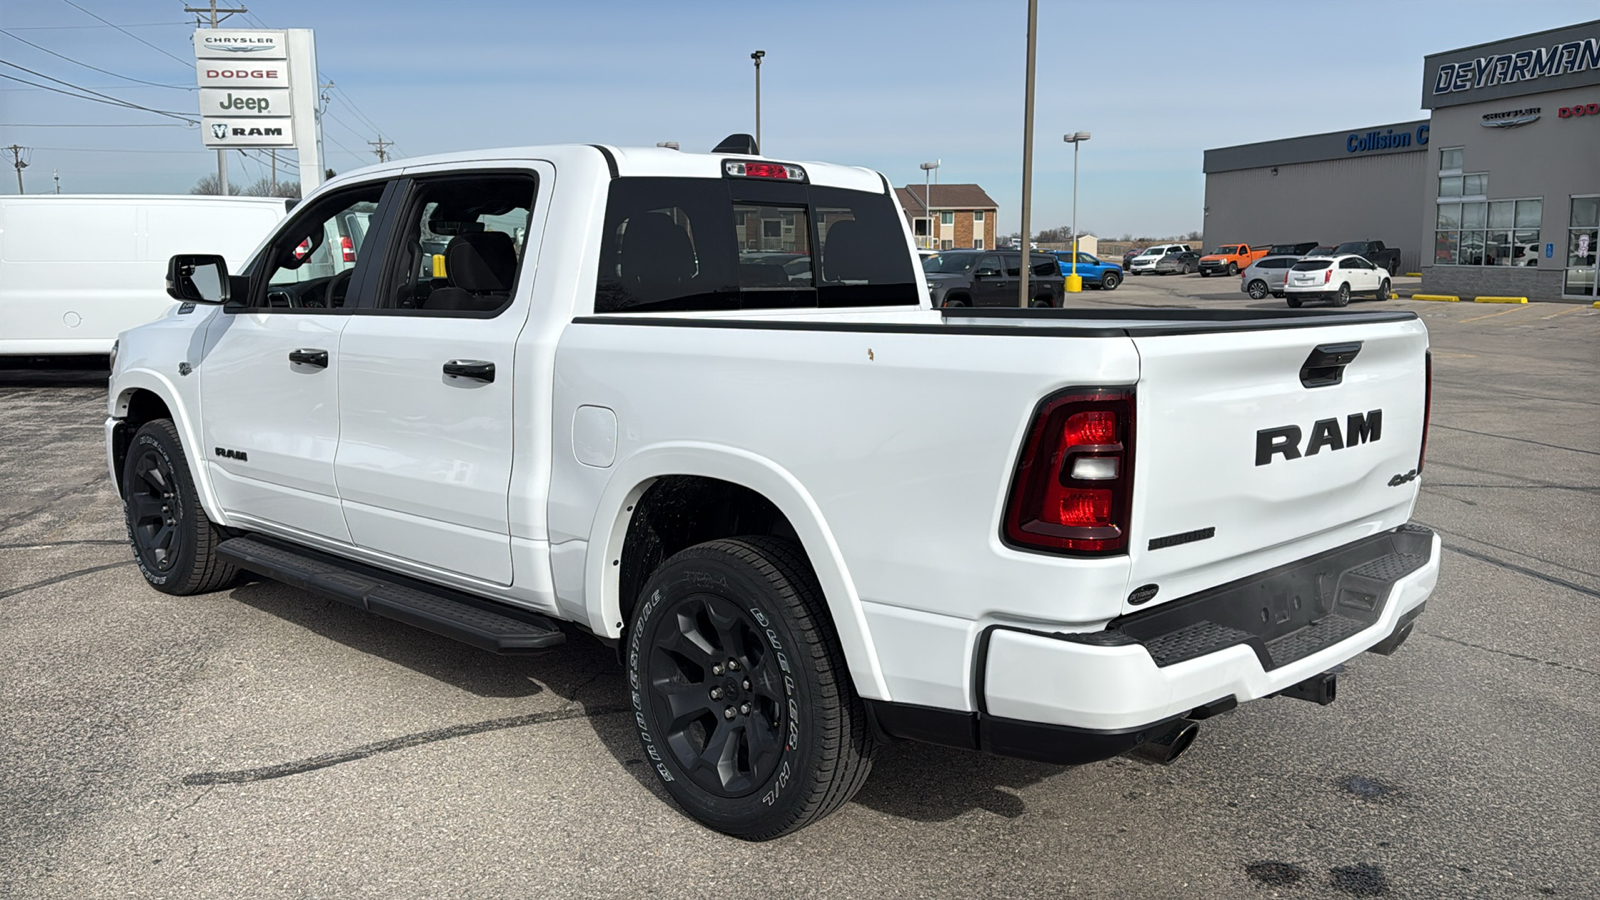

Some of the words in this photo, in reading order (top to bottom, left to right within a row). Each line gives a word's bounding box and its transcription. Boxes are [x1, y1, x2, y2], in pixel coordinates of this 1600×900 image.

[206, 69, 279, 79] DODGE
[1433, 38, 1600, 95] DEYARMAN
[219, 92, 270, 114] Jeep
[232, 127, 283, 136] RAM
[1347, 128, 1411, 153] Collision
[1255, 408, 1382, 467] RAM
[215, 446, 248, 462] RAM
[628, 589, 675, 783] BRIDGESTONE
[750, 607, 799, 750] DUELER
